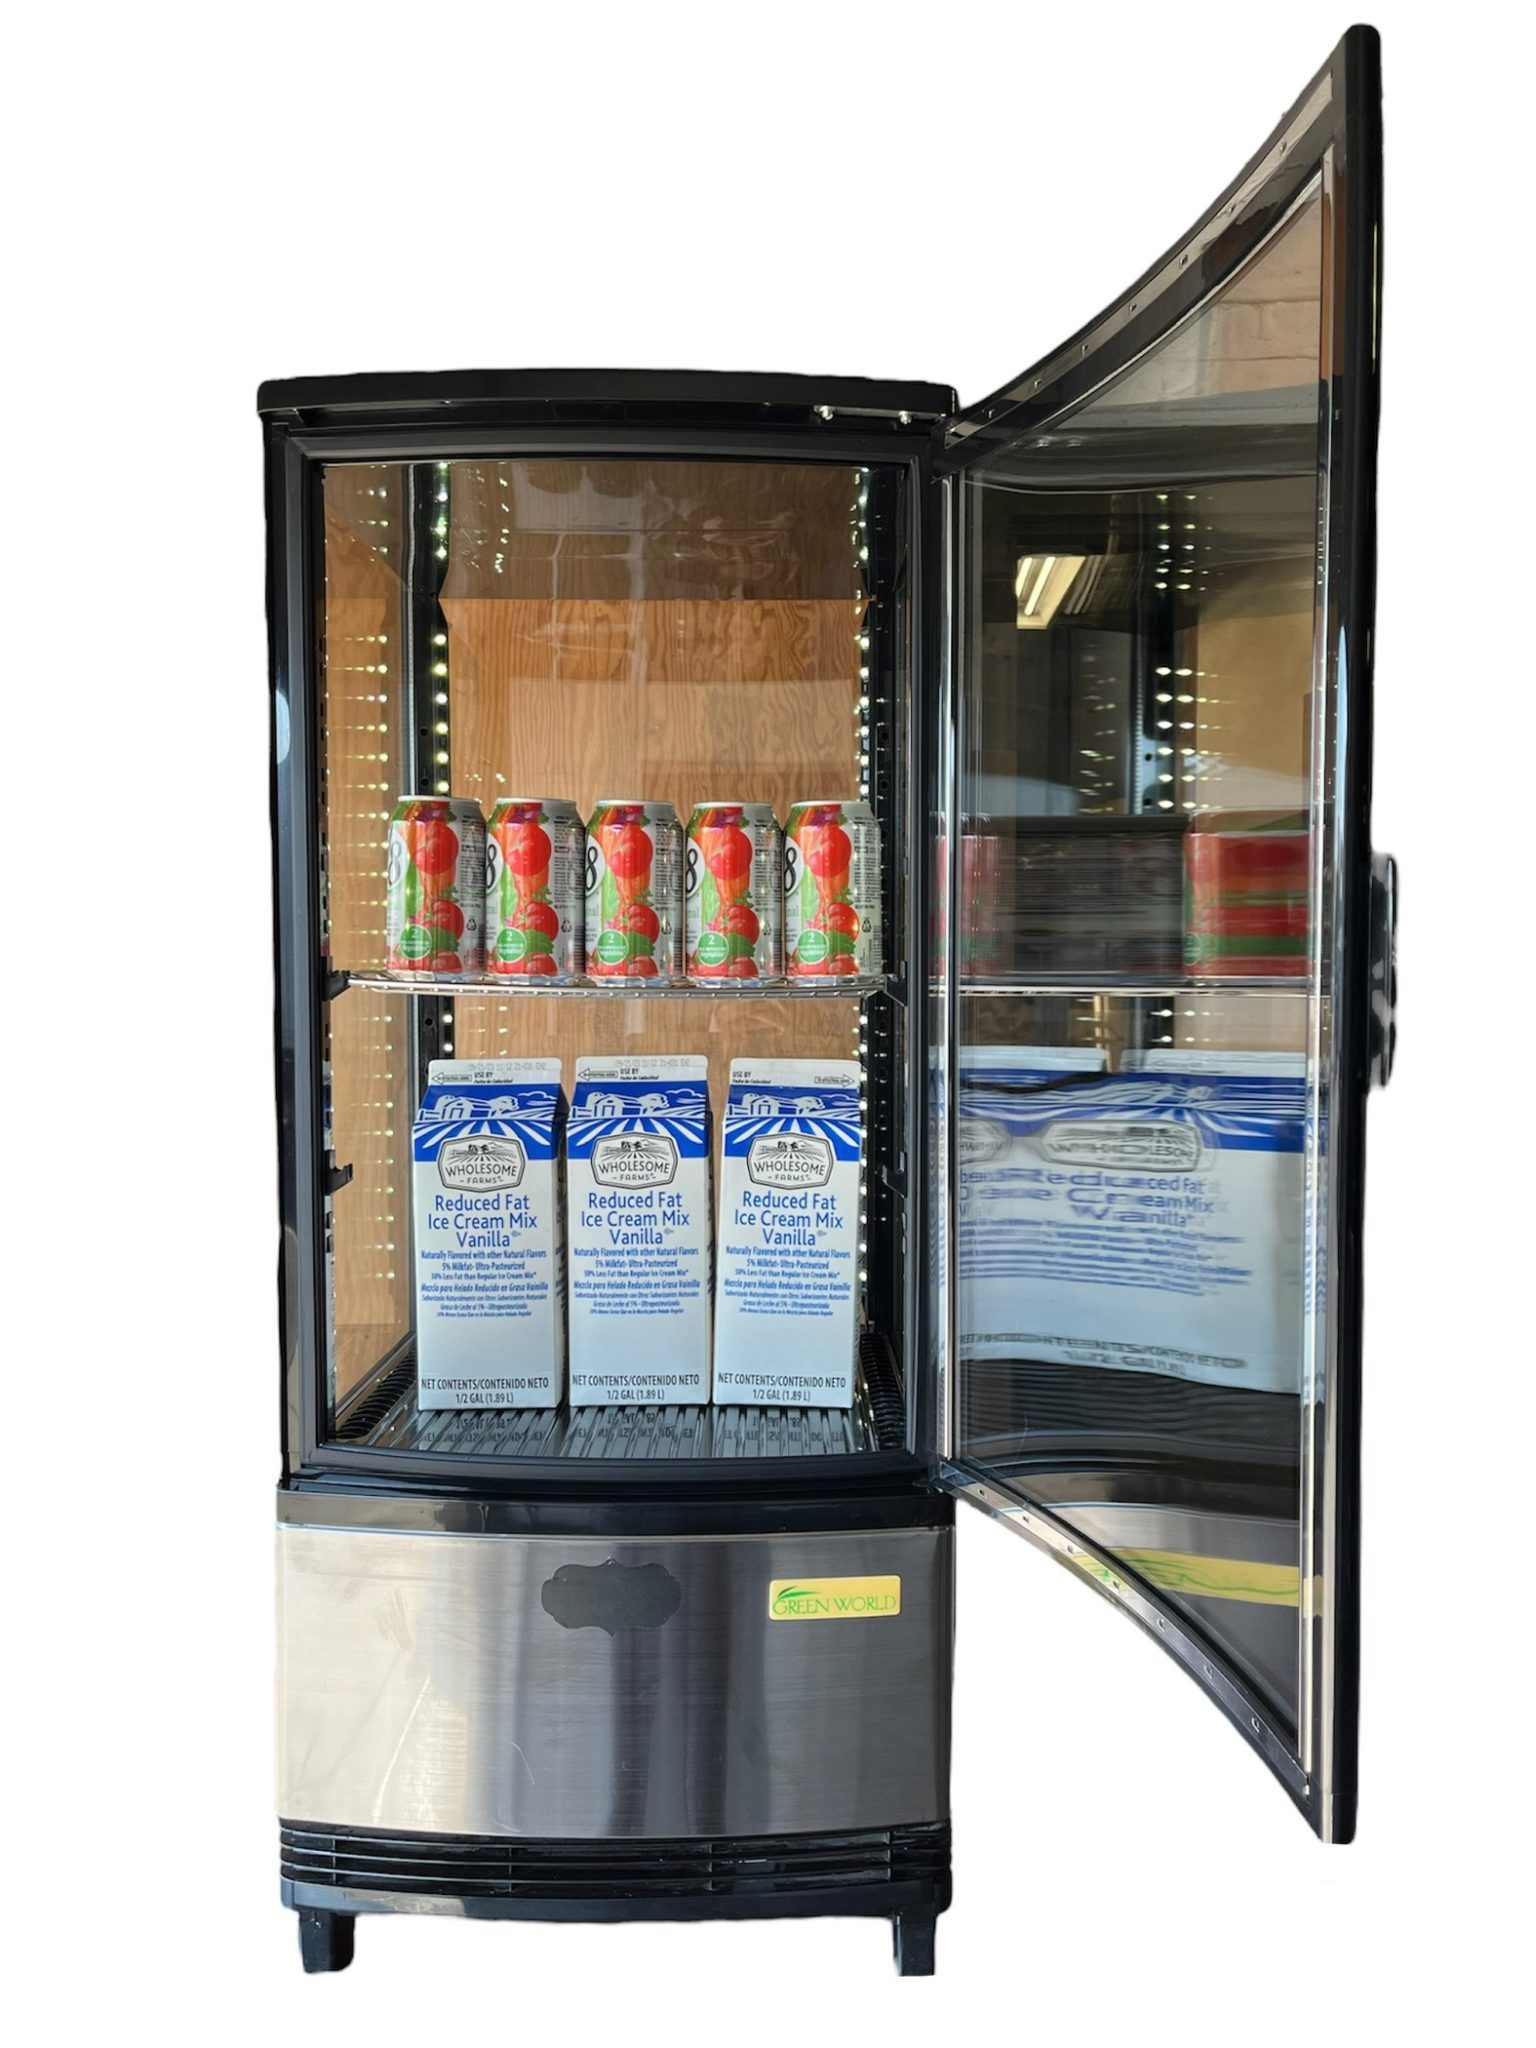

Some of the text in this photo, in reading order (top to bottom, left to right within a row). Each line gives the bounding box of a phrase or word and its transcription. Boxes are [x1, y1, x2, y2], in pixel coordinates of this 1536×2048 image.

[412, 930, 418, 938] 2
[506, 931, 512, 941] 2
[608, 934, 615, 942] 2
[708, 935, 714, 944] 2
[808, 933, 815, 942] 2
[445, 1163, 518, 1177] WHOLESOME
[598, 1160, 670, 1174] WHOLESOME
[754, 1160, 826, 1176] WHOLESOME
[435, 1193, 530, 1211] Reduced Fat
[588, 1190, 682, 1209] Reduced Fat
[743, 1190, 836, 1210] Reduced Fat
[428, 1212, 538, 1230] Ice Cream Mix
[582, 1209, 690, 1227] Ice Cream Mix
[735, 1209, 843, 1229] Ice Cream Mix
[456, 1230, 511, 1248] Vanilla
[609, 1227, 663, 1245] Vanilla
[762, 1228, 816, 1246] Vanilla
[421, 1249, 547, 1261] Naturally Flavored with other Natural Flavors
[574, 1246, 699, 1258] Naturally Flavored with other Natural Flavors
[421, 1377, 549, 1390] NET CONTENTS/CONTENIDO NETO
[573, 1374, 700, 1387] NET CONTENTS/CONTENIDO NETO
[718, 1372, 846, 1388] NET CONTENTS/CONTENIDO NETO
[456, 1392, 514, 1405] 1/2 GAL (1.89 L)
[608, 1389, 665, 1401] 1/2 GAL (1.89 L)
[752, 1389, 766, 1400] 1/2
[766, 1389, 780, 1400] GAL
[772, 1595, 896, 1615] GREEN WORLD
